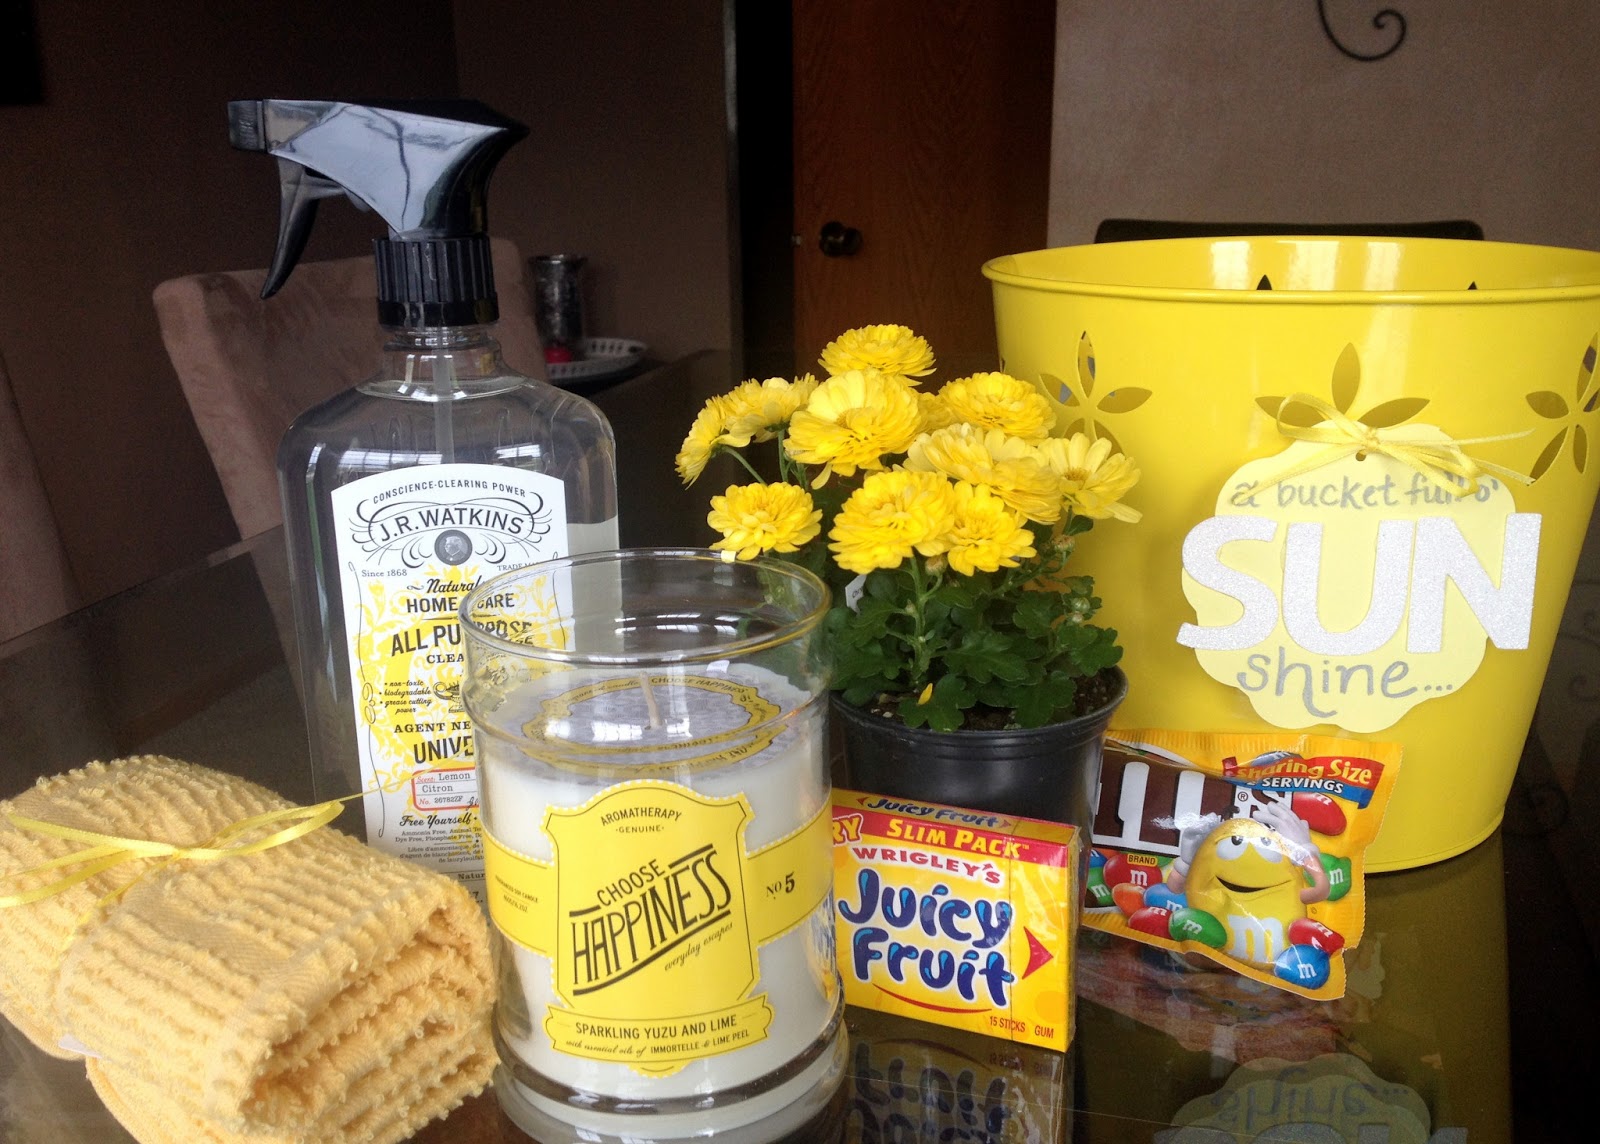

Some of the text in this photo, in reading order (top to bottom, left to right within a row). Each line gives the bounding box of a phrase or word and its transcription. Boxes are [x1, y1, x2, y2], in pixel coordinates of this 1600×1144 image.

[492, 482, 526, 497] POWER
[1231, 481, 1260, 507] a
[1277, 476, 1399, 509] bucket
[361, 568, 408, 578] Since 1868
[426, 575, 482, 594] Natural
[1176, 513, 1542, 656] SUN
[406, 597, 458, 613] HOME
[391, 628, 428, 657] ALL
[426, 653, 465, 664] CLEA
[384, 687, 432, 698] biodegradable
[394, 721, 472, 733] AGENT NE
[413, 735, 474, 764] UNIVE
[438, 772, 471, 781] Lemon
[1328, 759, 1372, 785] Size
[422, 784, 453, 793] Citron
[1262, 778, 1344, 794] SERVINGS
[400, 812, 472, 829] Free Yourself
[600, 807, 682, 826] AROMATHERAPY
[867, 798, 1000, 828] Juicy Fruit
[618, 824, 662, 833] GENUINE
[886, 818, 947, 846] SLIM
[852, 847, 1000, 884] WRIGLEY'S
[1128, 855, 1156, 864] BRAND
[458, 872, 485, 880] Natur
[597, 858, 665, 906] CHOOSE
[785, 871, 795, 894] 5
[571, 849, 732, 985] HAPPINESS
[838, 868, 1013, 949] Juicy
[664, 922, 733, 971] everyday escapes
[853, 927, 1015, 1007] Fruit
[575, 1014, 737, 1040] SPARKLING YUZU AND LIME
[990, 1016, 1054, 1039] 15 STICKS GUM
[650, 1042, 699, 1054] IMMORTELLE
[712, 1035, 730, 1046] LIME
[732, 1029, 749, 1041] PEEL
